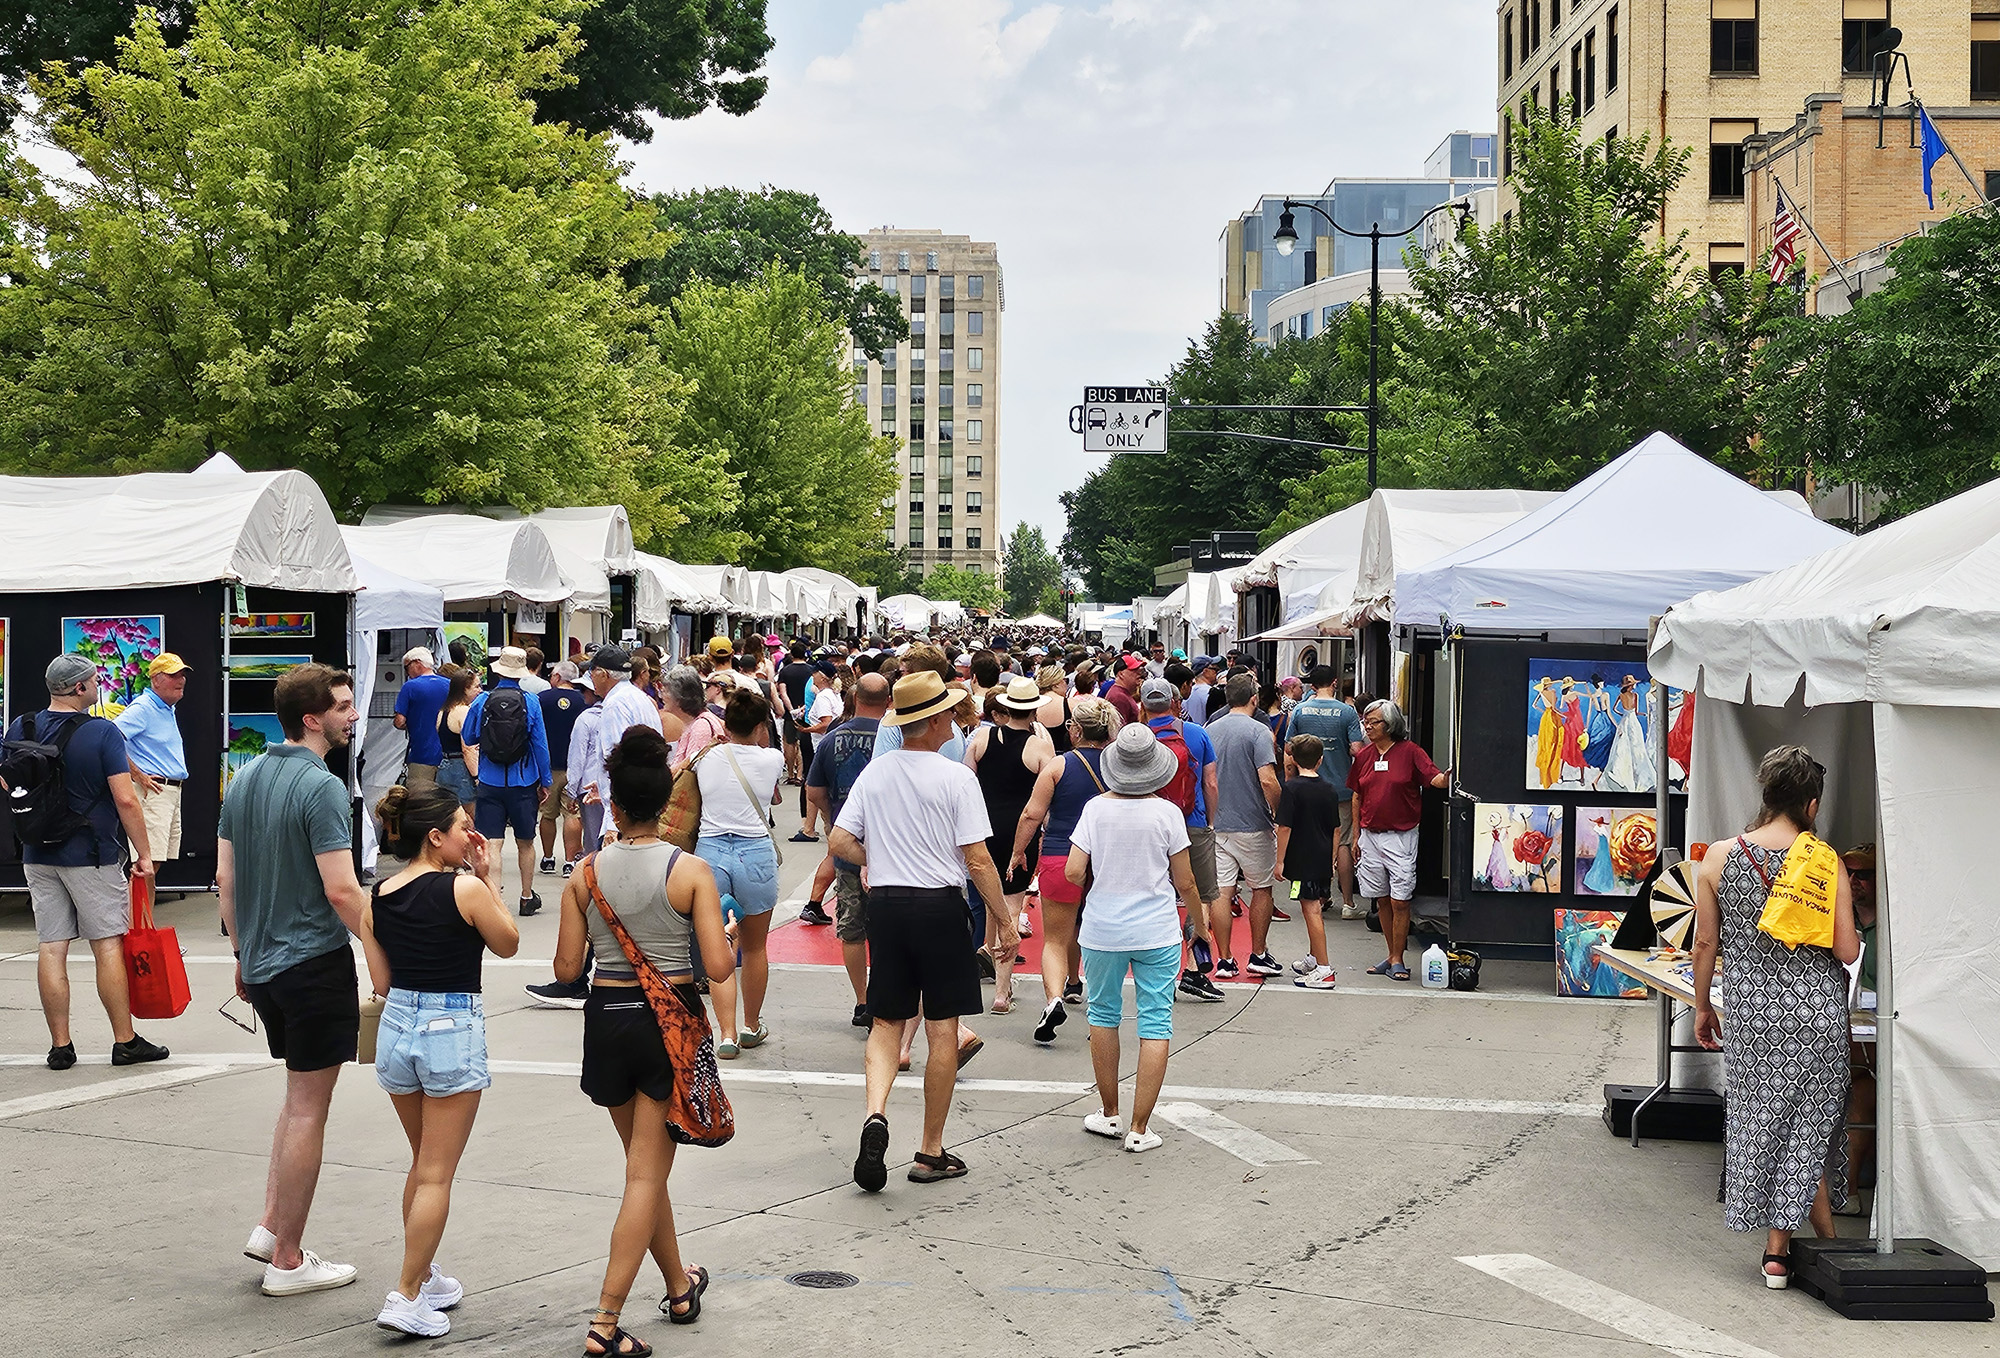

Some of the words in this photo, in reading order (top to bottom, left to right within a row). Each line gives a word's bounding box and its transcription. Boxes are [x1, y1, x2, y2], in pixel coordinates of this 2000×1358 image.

[1088, 388, 1117, 402] BUS
[1125, 388, 1163, 402] LANE
[1132, 414, 1140, 424] &
[1105, 433, 1144, 447] ONLY
